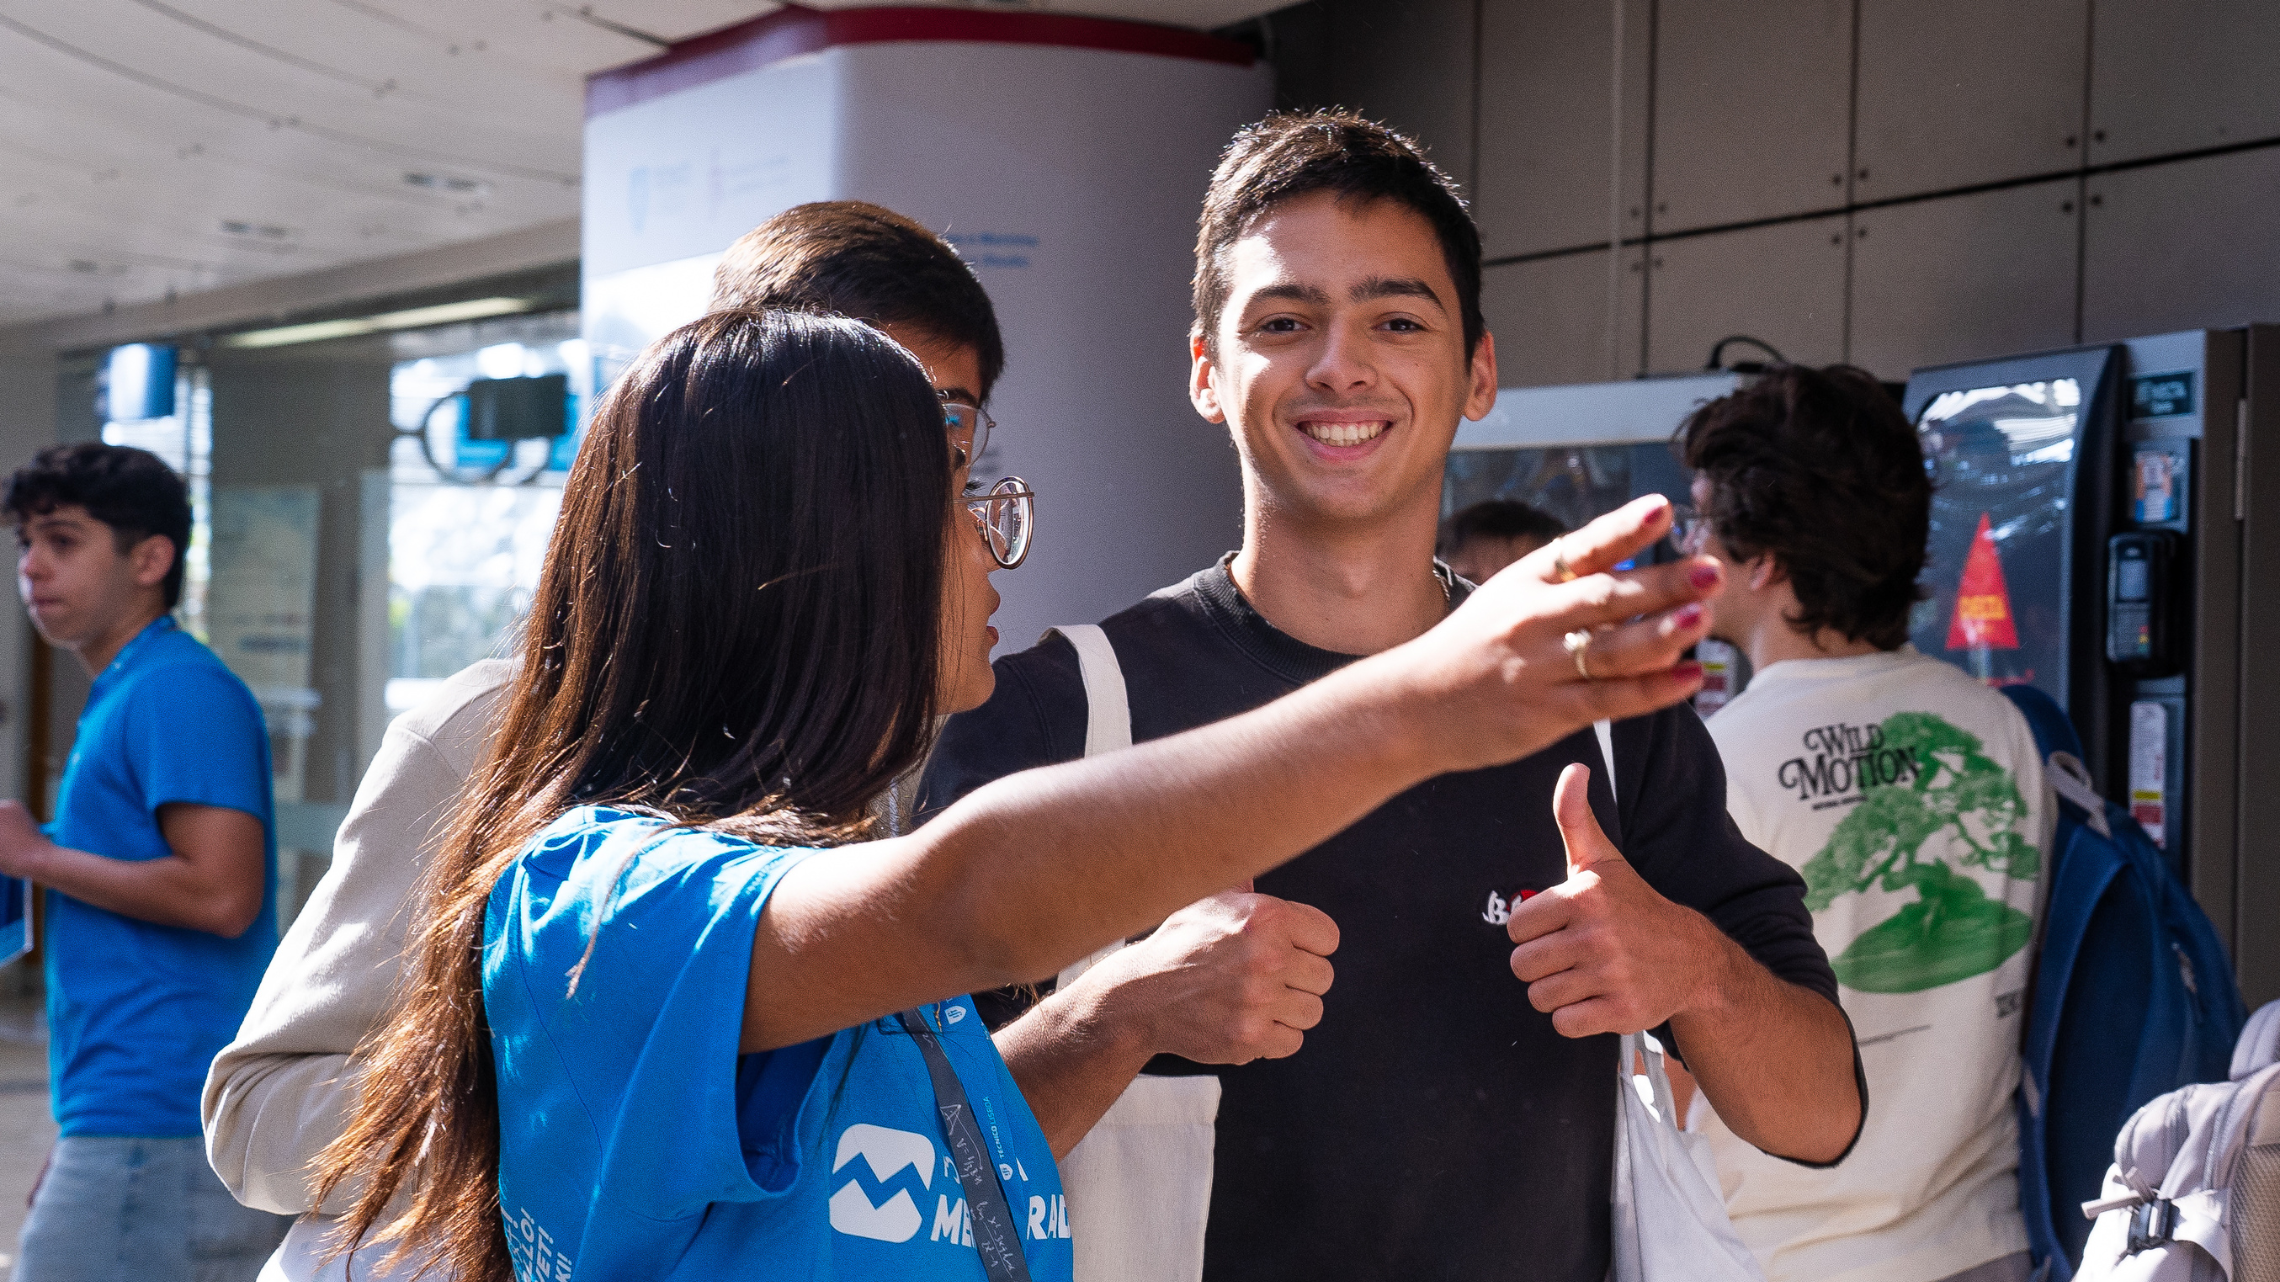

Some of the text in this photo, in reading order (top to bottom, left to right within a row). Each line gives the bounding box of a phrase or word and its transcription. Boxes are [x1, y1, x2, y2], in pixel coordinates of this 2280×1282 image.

[1803, 723, 1884, 756] WILD
[1778, 746, 1919, 800] MOTION
[983, 1096, 997, 1125] LISBOA
